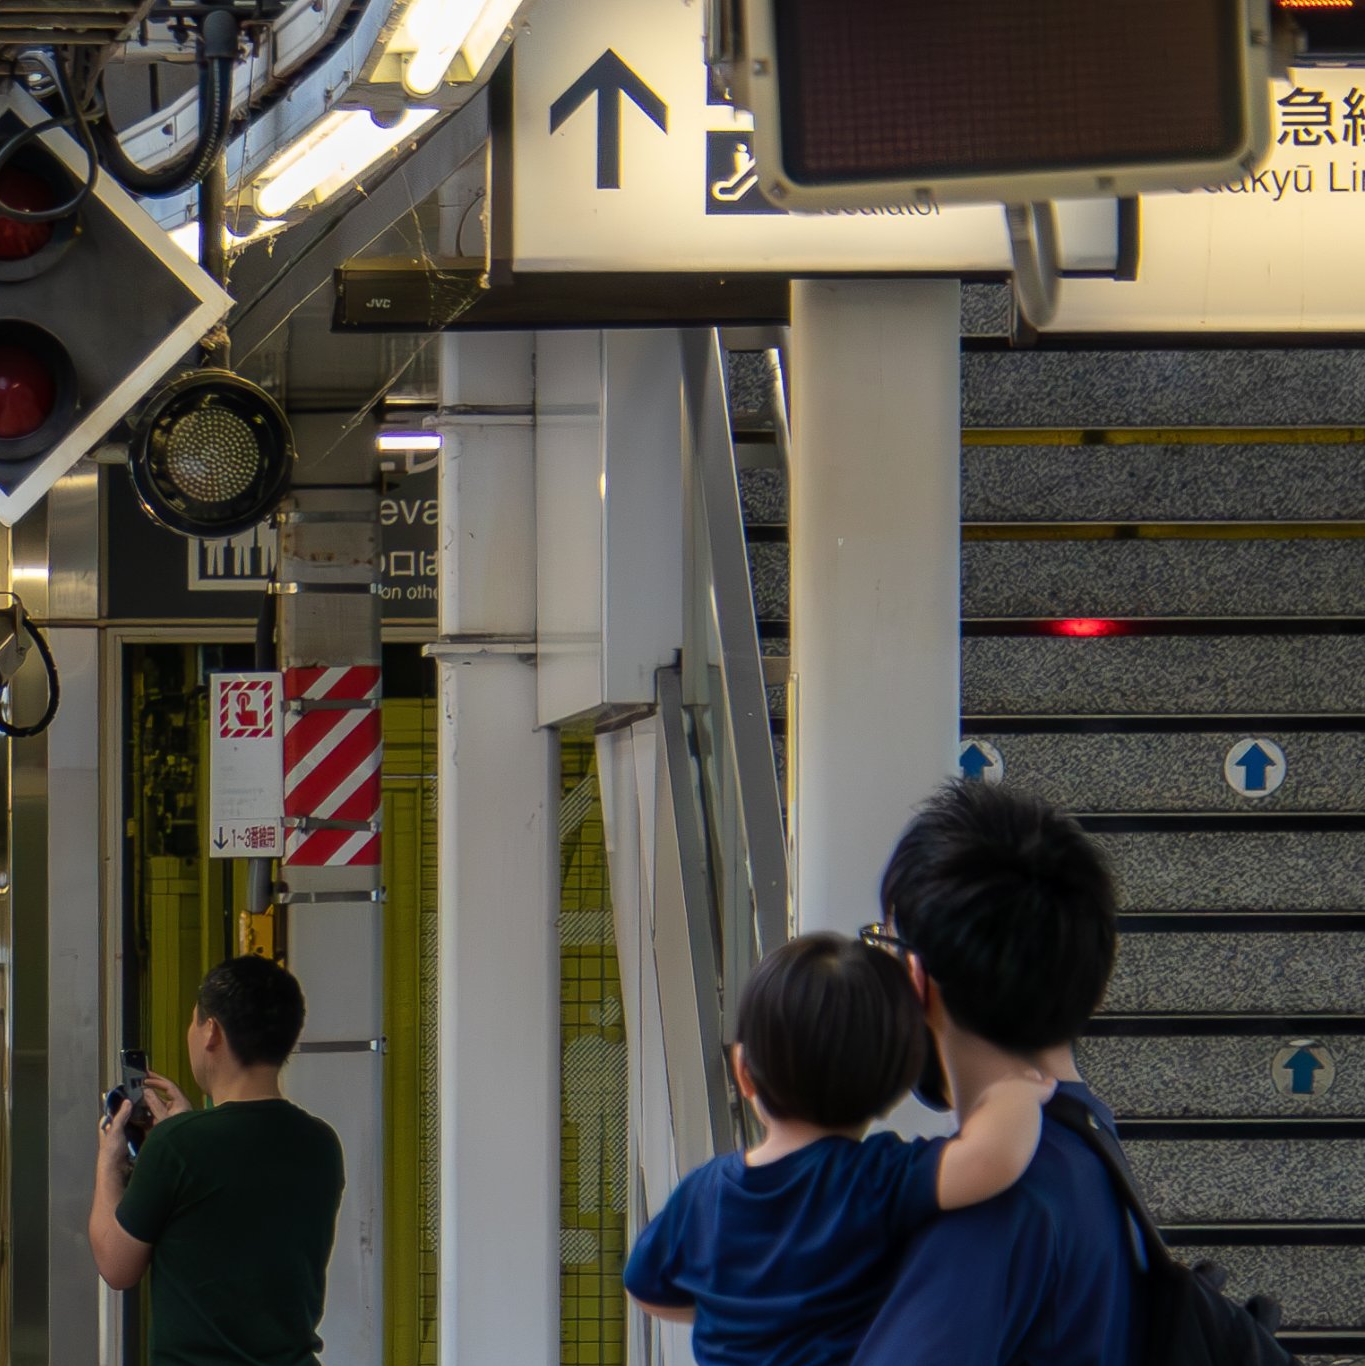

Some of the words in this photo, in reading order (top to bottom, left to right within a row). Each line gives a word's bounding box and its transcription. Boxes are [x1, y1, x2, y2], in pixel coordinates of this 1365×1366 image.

[1174, 164, 1312, 201] akyū
[1329, 161, 1365, 192] Li
[366, 299, 391, 308] JVC
[381, 551, 438, 577] 口は
